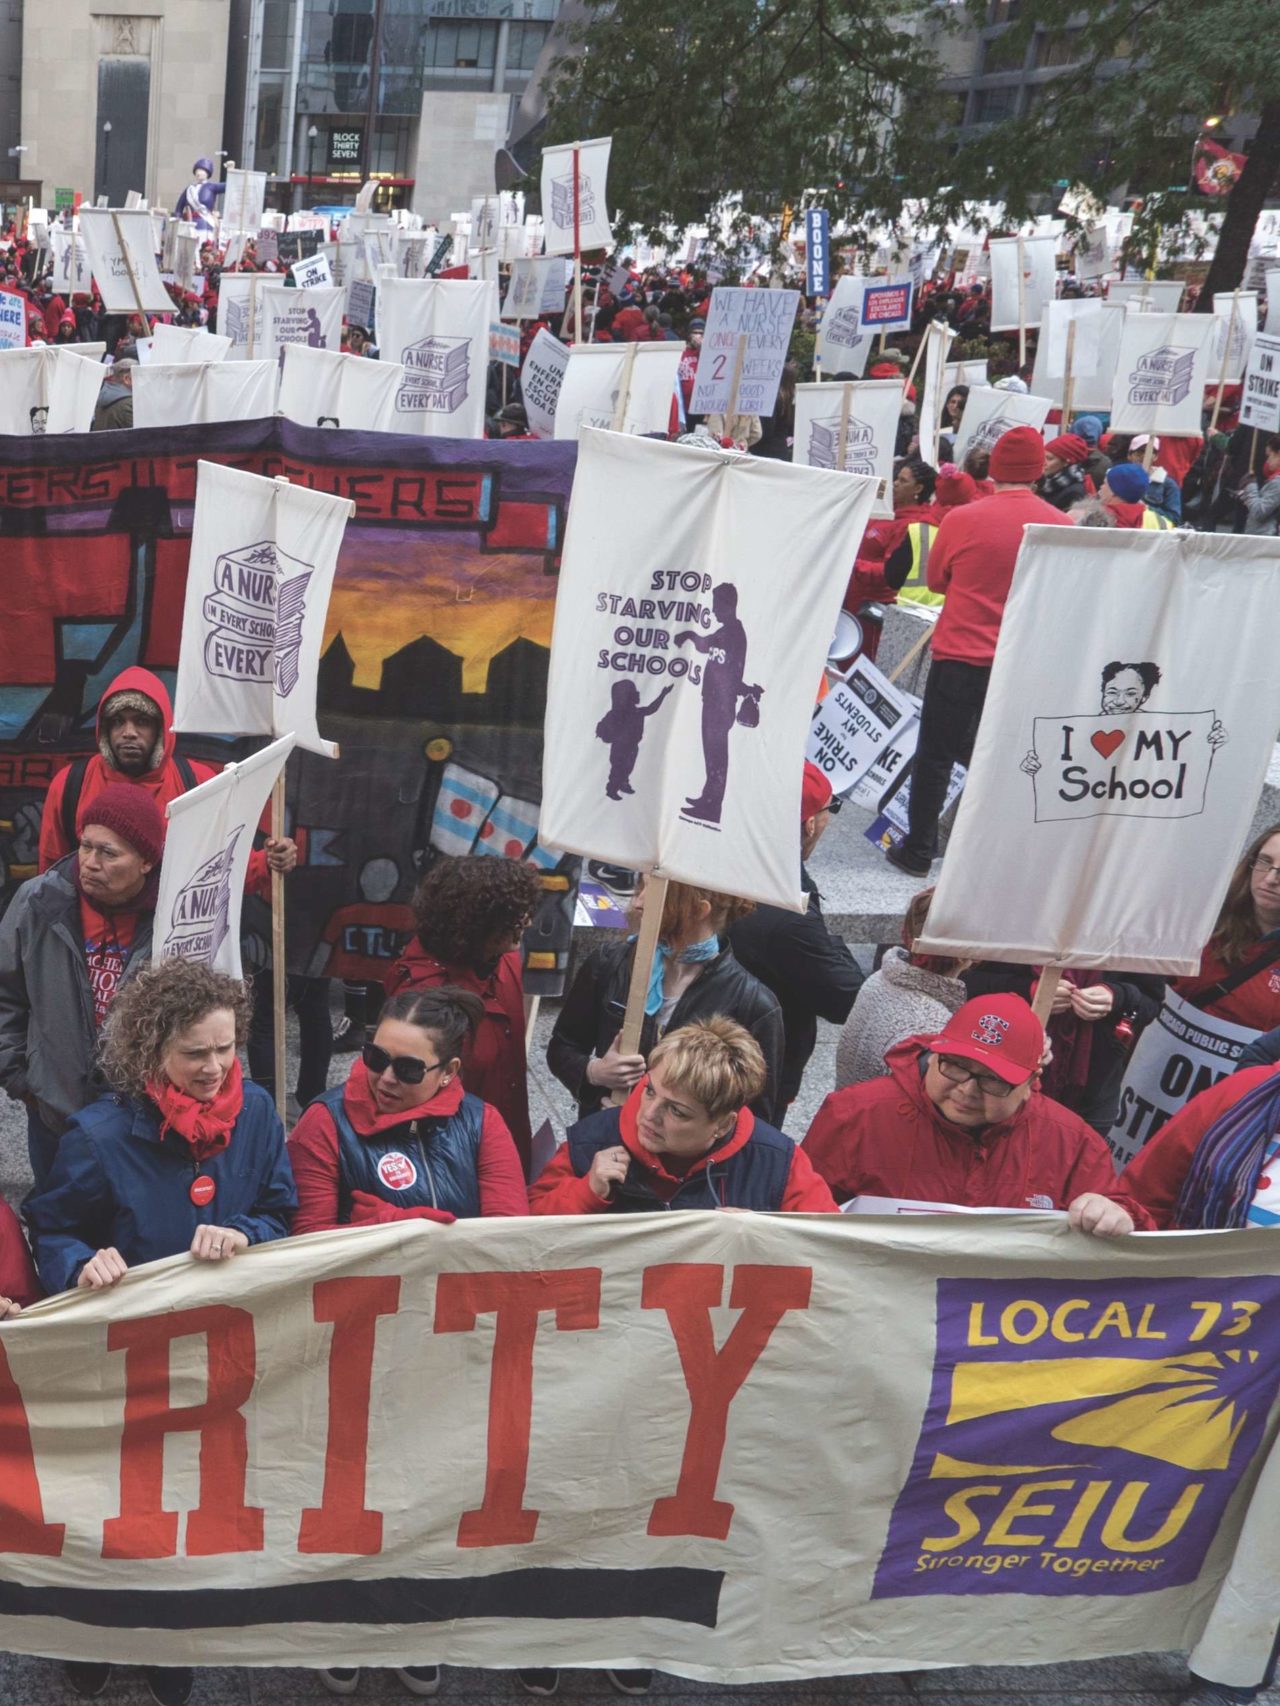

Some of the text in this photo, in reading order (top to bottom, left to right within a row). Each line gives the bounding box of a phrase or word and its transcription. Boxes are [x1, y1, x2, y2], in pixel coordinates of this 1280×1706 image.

[333, 133, 360, 141] BLOCK
[333, 141, 360, 149] THIRTY
[332, 150, 357, 158] SEVEN
[812, 213, 823, 292] BOONE
[306, 268, 318, 278] ON
[714, 291, 795, 316] WE HAVE
[738, 313, 785, 334] NURSE
[747, 333, 786, 350] EVERY
[405, 351, 444, 372] A NURSE
[711, 354, 727, 381] 2
[1140, 358, 1148, 370] A
[1261, 353, 1273, 372] ON
[531, 374, 544, 386] EN
[1248, 374, 1280, 398] STRIKE
[400, 393, 448, 409] EVERY DAY
[524, 388, 546, 411] CADA
[1133, 389, 1160, 402] EVERY
[220, 563, 234, 592] A
[651, 570, 712, 593] STOP
[220, 609, 249, 633] EVERY
[596, 592, 711, 629] STARVING
[614, 626, 669, 649] OUR
[215, 642, 272, 677] EVERY
[597, 649, 702, 686] SCHOOLS
[834, 692, 882, 743] STUDENTS
[841, 718, 859, 737] MY
[814, 722, 858, 771] STRIKE
[1061, 725, 1192, 761] I MY
[814, 747, 836, 772] ON
[1058, 763, 1187, 802] School
[176, 895, 187, 922] A
[345, 927, 396, 957] CTU
[1185, 1028, 1229, 1054] PUBLIC
[967, 1298, 1262, 1347] LOCAL 73
[920, 1479, 1205, 1553] SEIU
[914, 1551, 1165, 1578] Stronger Together
